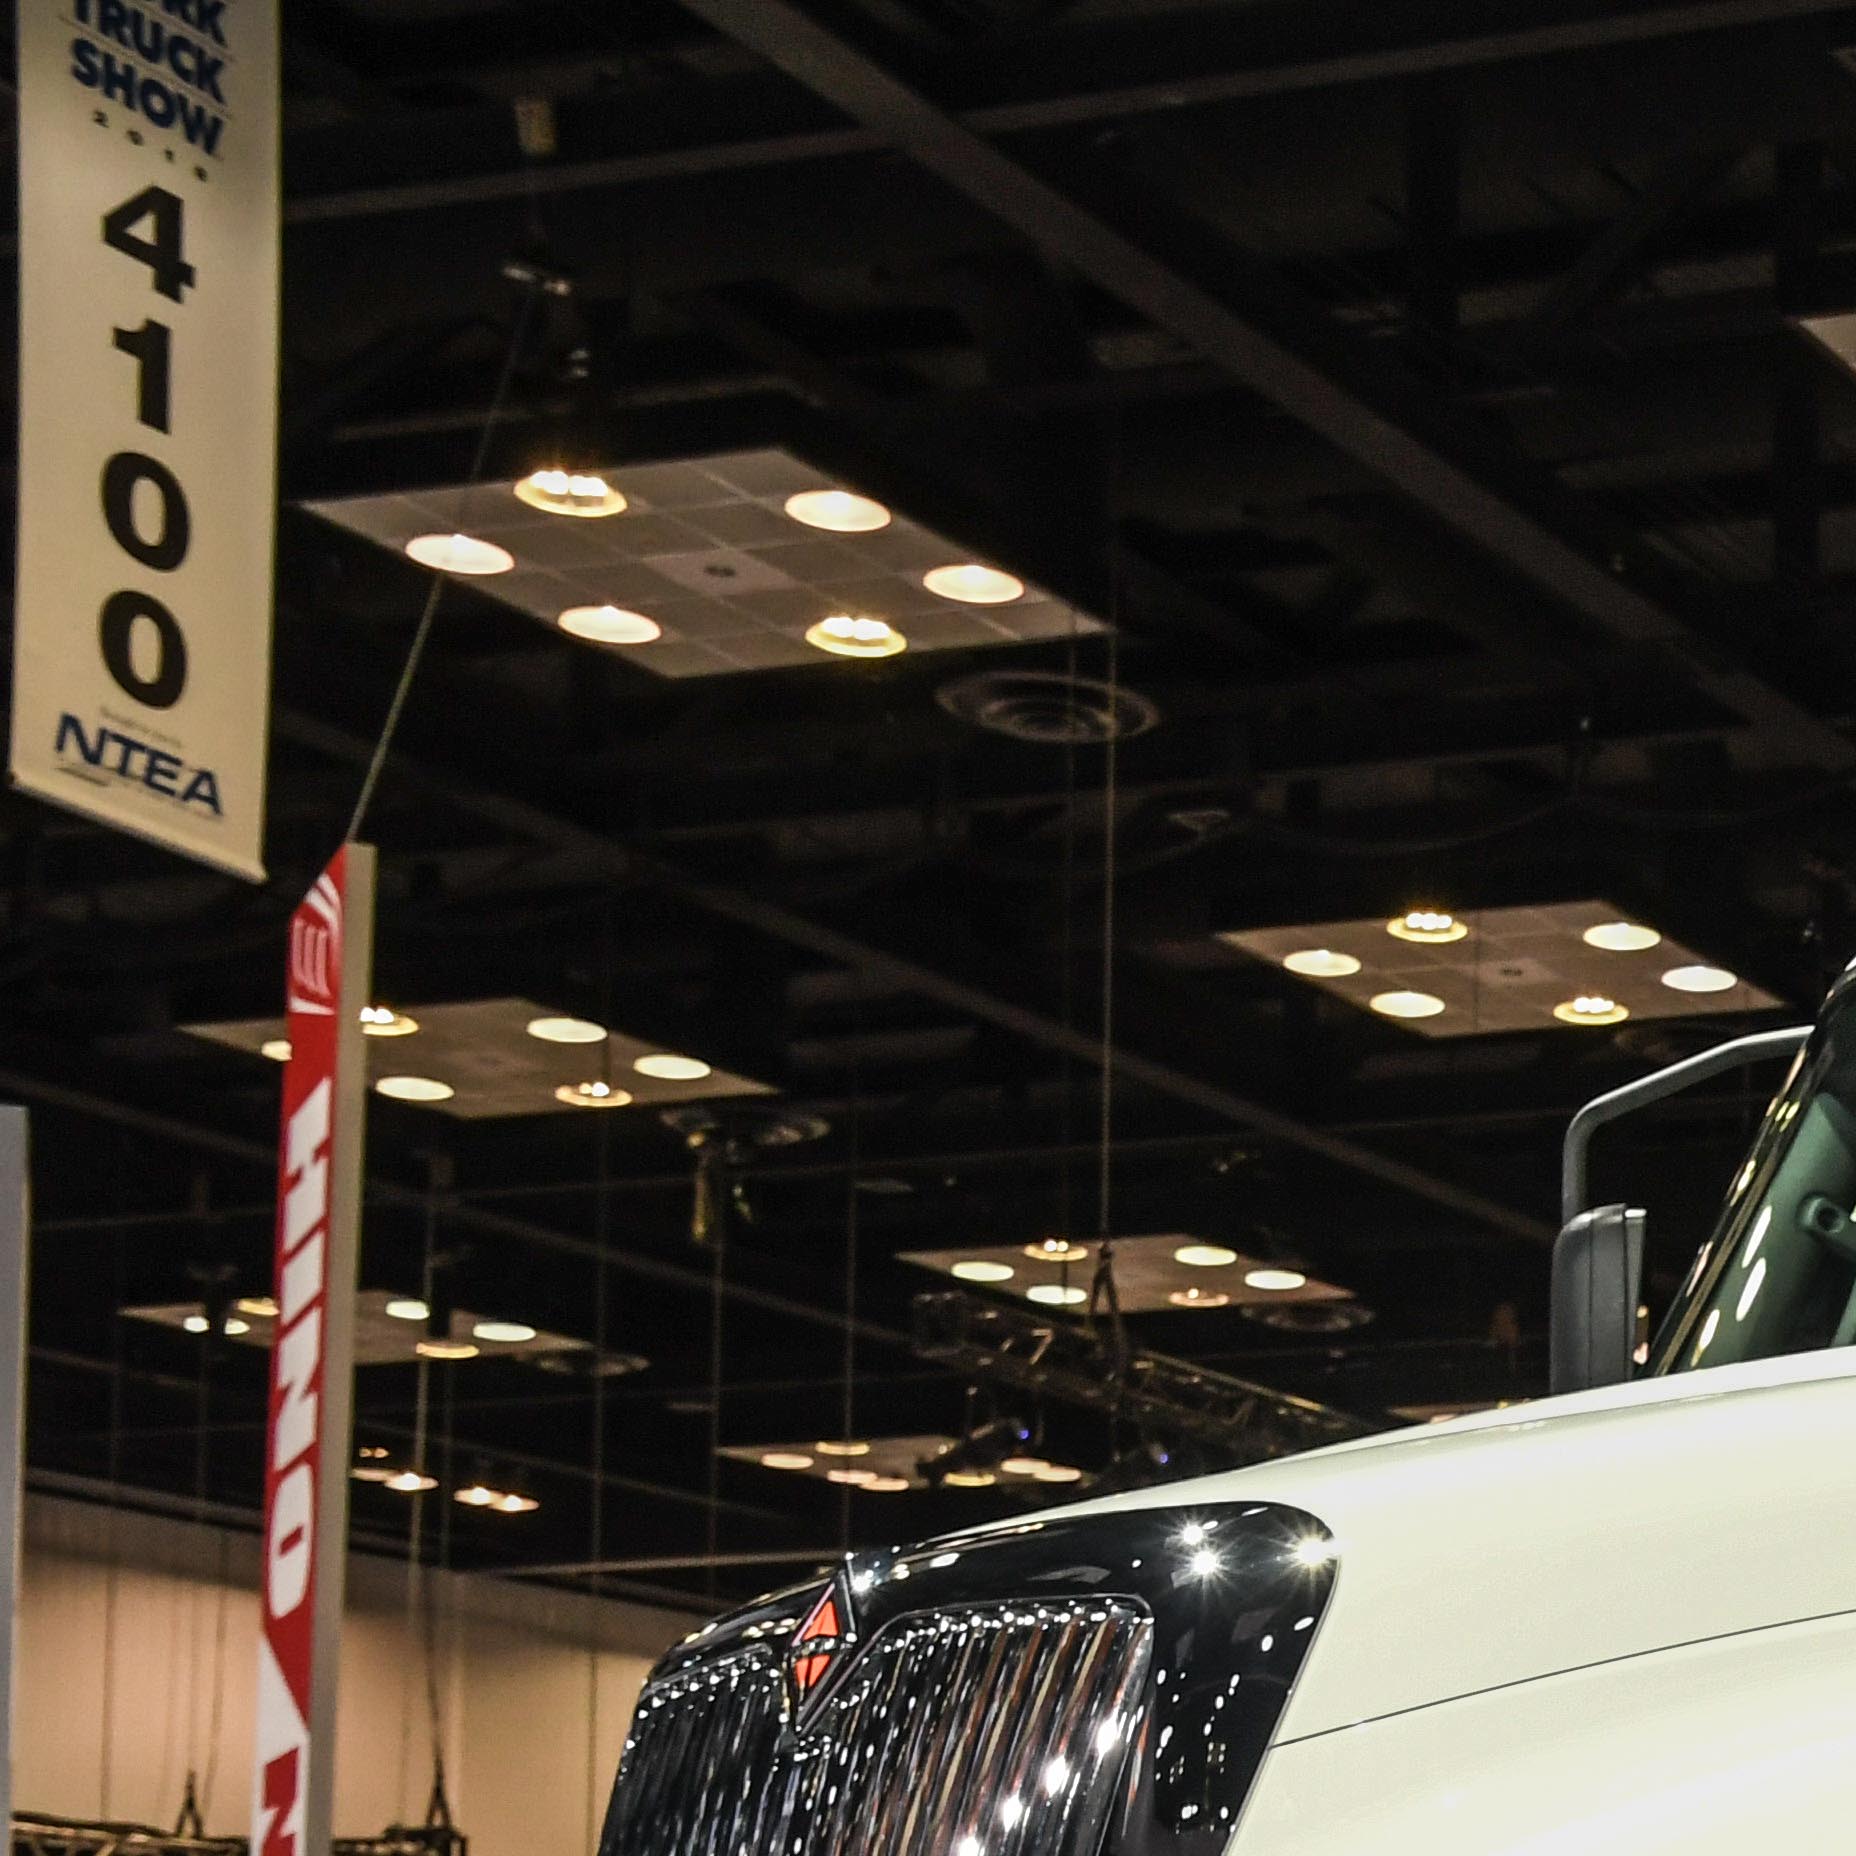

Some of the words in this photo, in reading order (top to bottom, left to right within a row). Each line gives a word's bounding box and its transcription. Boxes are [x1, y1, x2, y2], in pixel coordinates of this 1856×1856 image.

[72, 38, 223, 154] SHOW
[101, 185, 196, 711] 4100
[56, 714, 223, 814] NTEA
[271, 1077, 333, 1618] HINO
